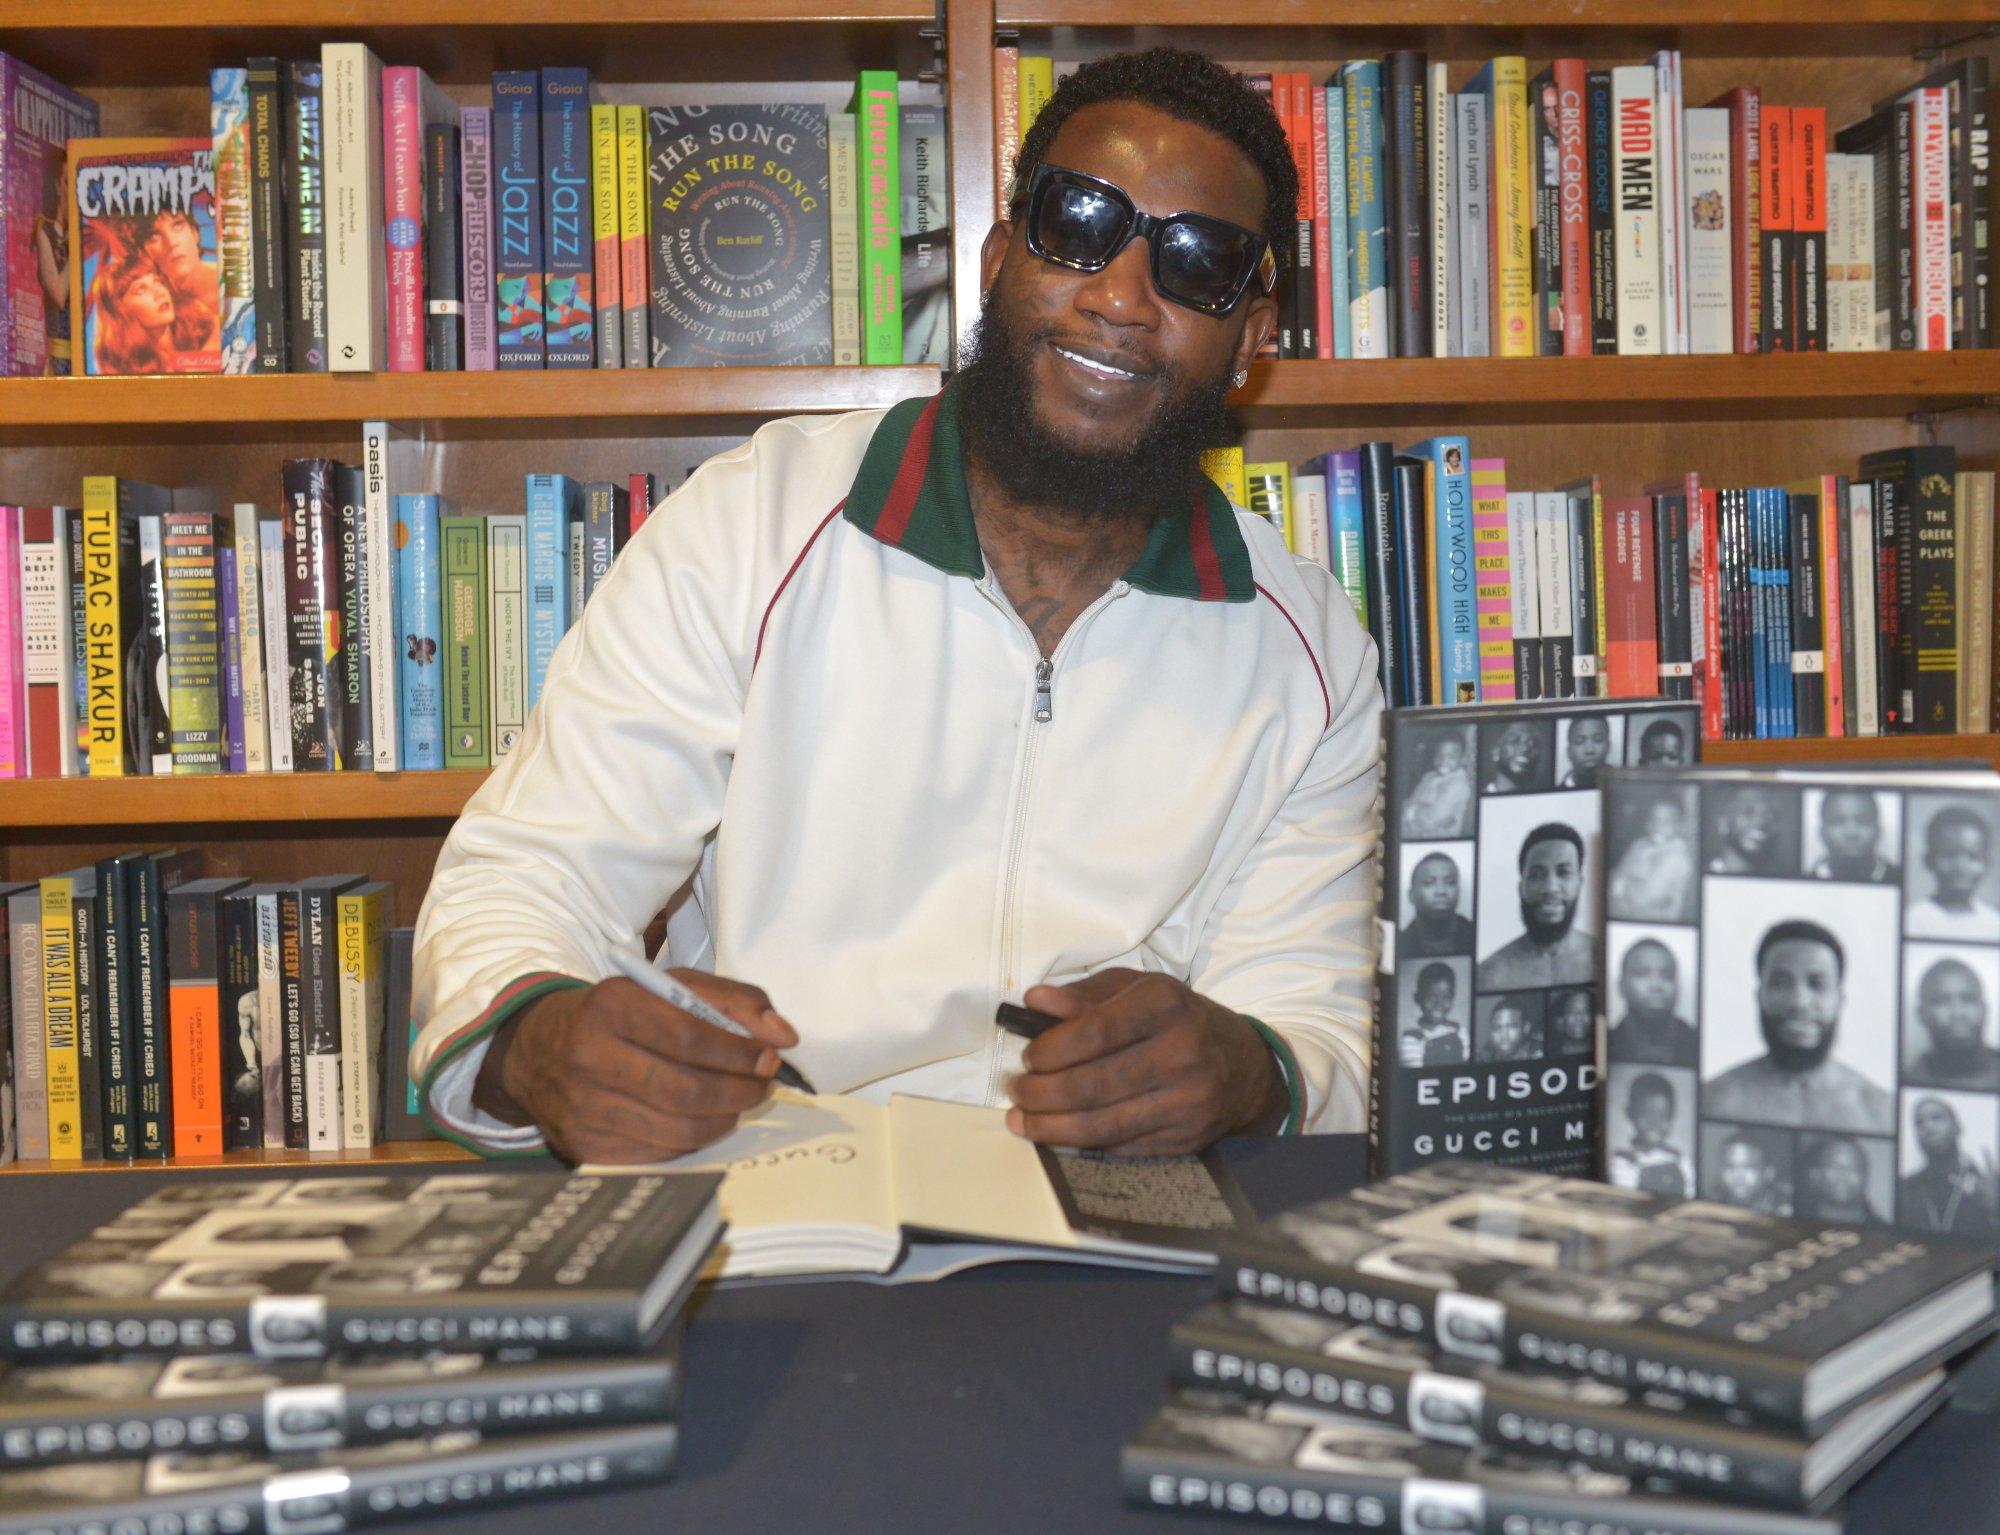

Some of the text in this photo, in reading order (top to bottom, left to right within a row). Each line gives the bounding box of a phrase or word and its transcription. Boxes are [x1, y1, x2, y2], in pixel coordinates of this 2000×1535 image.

[497, 82, 533, 94] Gioia
[547, 82, 583, 95] Gioia
[256, 94, 268, 132] TOTAL
[257, 135, 269, 178] CHAOS
[512, 101, 524, 172] The History of
[563, 101, 575, 172] The History of
[916, 138, 929, 171] Keith
[1313, 91, 1328, 218] WES ANDERSON
[1328, 91, 1344, 218] WES ANDERSON
[1466, 101, 1480, 192] Lynch on Lynch
[1561, 90, 1584, 223] CRISS-CROSS
[1593, 90, 1608, 214] GEORGE CLOONEY
[1620, 97, 1653, 211] MAD MEN
[1690, 152, 1725, 161] OSCAR
[1970, 129, 1989, 170] RAP
[192, 151, 212, 172] TH
[299, 97, 322, 234] BUZZ ME IN
[867, 90, 895, 249] Futuromania
[1694, 167, 1723, 175] WARS
[662, 154, 818, 213] RUN THE SONG
[916, 175, 930, 233] Richards
[502, 167, 536, 255] Jazz
[552, 167, 586, 255] Jazz
[714, 196, 784, 246] RUN THE SONG
[599, 117, 614, 350] RUN THE SONG RATLIFF
[625, 117, 641, 349] RUN THE SONG RATLIFF
[392, 251, 403, 286] Presley
[917, 243, 932, 268] Life
[300, 249, 312, 320] Plant Studios
[311, 249, 324, 337] Inside the Record
[404, 251, 416, 335] Priscilla Beaulieu
[500, 353, 541, 362] OXFORD
[549, 353, 589, 362] OXFORD
[368, 436, 383, 493] oasis
[591, 491, 599, 524] Skinner
[598, 491, 608, 512] Doug
[1478, 502, 1500, 511] WHAT
[1882, 483, 1894, 537] KRAMER
[1926, 510, 1947, 522] THE
[172, 524, 207, 535] MEET ME
[294, 492, 308, 579] PUBLIC
[534, 493, 554, 580] GREIL MARCUS
[1376, 492, 1392, 561] Remotely
[1482, 530, 1500, 539] THIS
[1616, 511, 1626, 563] TRAGEDIES
[1630, 511, 1642, 582] FOUR REVENGE
[1919, 529, 1953, 541] GREEK
[177, 546, 203, 556] IN THE
[572, 535, 580, 577] TWEEDY
[1339, 530, 1361, 587] RAINBOW
[1447, 480, 1470, 634] HOLLYWOOD HIGH
[1479, 559, 1505, 568] PLACE
[1920, 548, 1954, 559] PLAYS
[168, 568, 212, 578] BATHROOM
[242, 535, 257, 637] SCHOENBERG
[1479, 587, 1507, 596] MAKES
[343, 505, 359, 703] OF OPERA YUVAL SHARON
[454, 579, 464, 642] HARRISON
[464, 585, 473, 636] GEORGE
[1488, 615, 1500, 625] ME
[87, 511, 115, 743] TUPAC SHAKUR
[1452, 639, 1463, 674] Handy
[1464, 641, 1473, 671] Bruce
[1553, 643, 1563, 671] Albert
[251, 683, 260, 723] HARVEY
[303, 658, 314, 723] SAVAGE
[317, 674, 326, 708] JON
[186, 731, 208, 741] LIZZY
[176, 752, 217, 763] GOODMAN
[45, 928, 68, 940] IT
[107, 936, 117, 967] CAN'T
[141, 934, 151, 965] CAN'T
[282, 898, 299, 978] JEFF TWEEDY
[344, 903, 360, 983] DEBUSSY
[46, 942, 69, 970] WAS
[79, 949, 89, 986] HISTORY
[309, 896, 324, 1028] DYLAN Goes Electric!
[47, 971, 70, 994] ALL
[81, 994, 90, 1011] LOL
[108, 969, 119, 1026] REMEMBER
[142, 967, 153, 1024] REMEMBER
[48, 1007, 73, 1048] DREAM
[82, 1012, 91, 1057] TOLHURST
[111, 1029, 120, 1039] IF
[144, 1027, 154, 1037] IF
[111, 1048, 121, 1079] CRIED
[145, 1045, 155, 1077] CRIED
[286, 984, 303, 1123] LET'S GO (SO WE CAN GET BACK)
[1417, 1064, 1597, 1105] EPISOD
[1414, 1126, 1537, 1155] GUCCI
[13, 1315, 572, 1348] EPISODES GUCCI MANE
[1236, 1267, 1739, 1405] EPISODES GUCCI MANE
[3, 1389, 604, 1458] EPISODES GUCCI MANE
[1191, 1350, 1736, 1483] EPISODES GUCCI MANE
[368, 1473, 492, 1511] GUCCI
[503, 1456, 610, 1491] MANE
